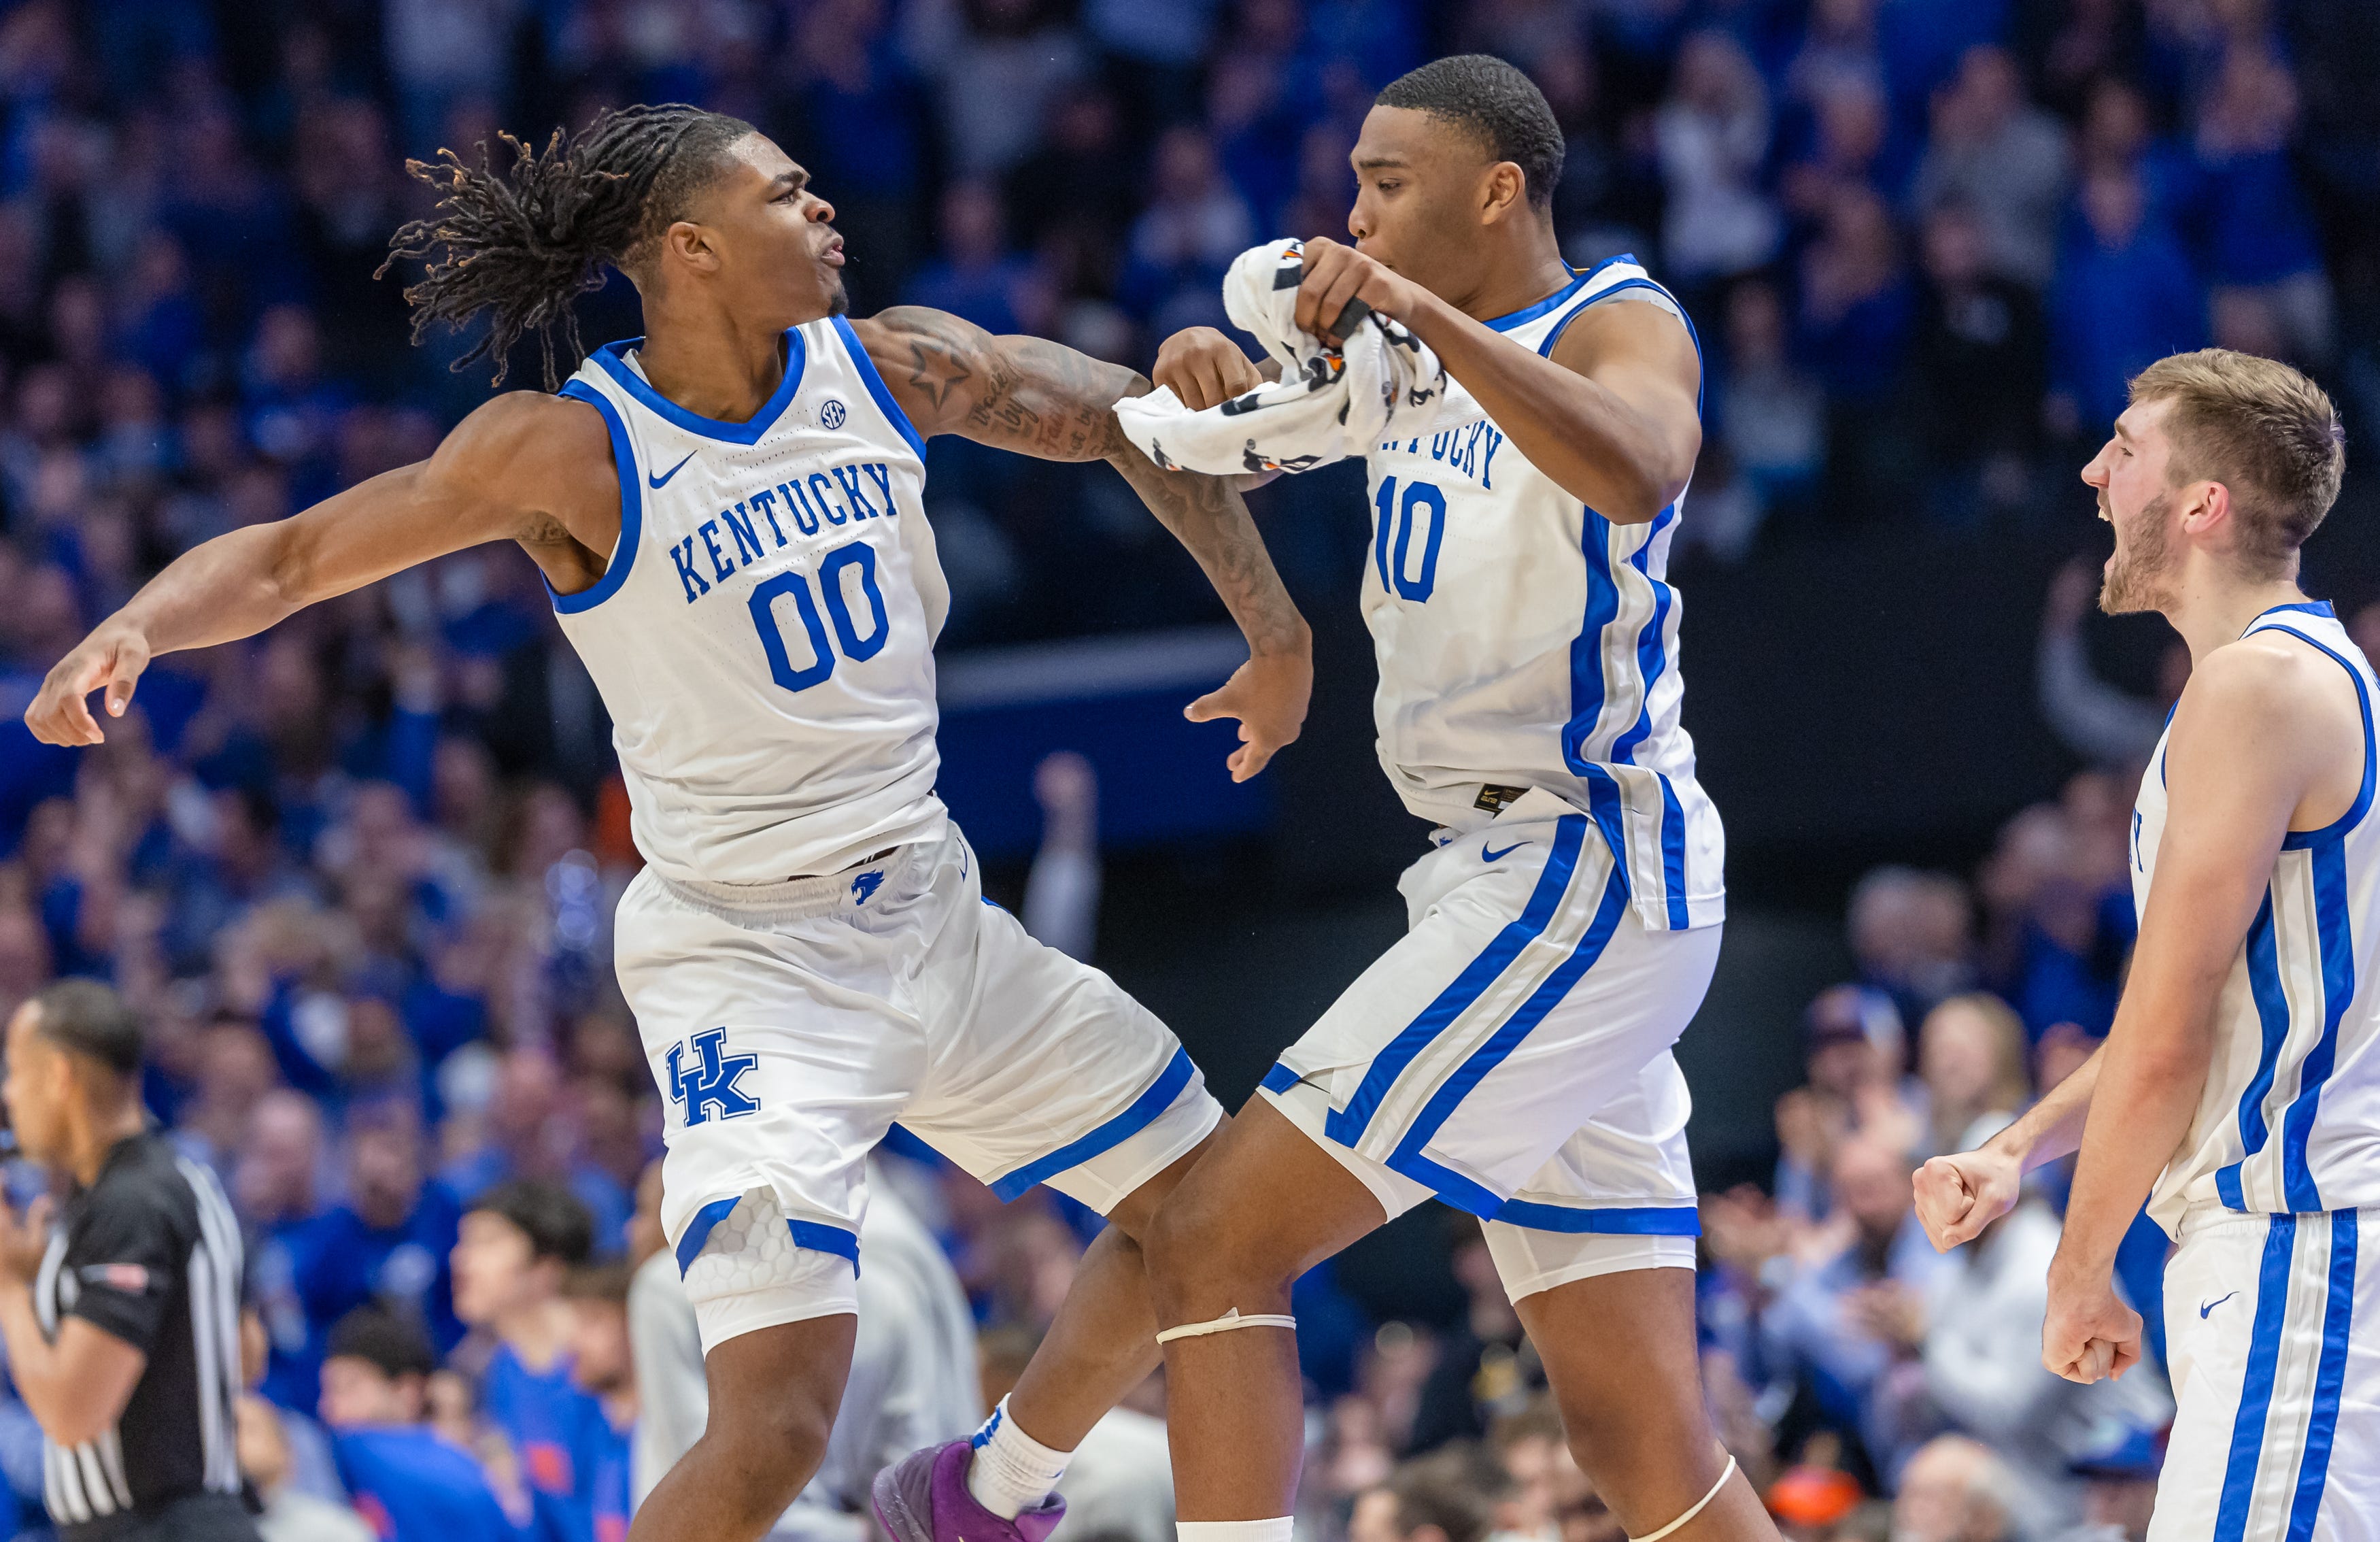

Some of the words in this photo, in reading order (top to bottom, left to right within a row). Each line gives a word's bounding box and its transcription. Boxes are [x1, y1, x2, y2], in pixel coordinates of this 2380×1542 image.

[821, 400, 845, 429] SEC
[1382, 420, 1503, 490] UCKY
[669, 463, 897, 604] KENTUCKY
[1375, 475, 1447, 604] 10
[747, 541, 889, 692] 00
[666, 1026, 761, 1128] UK
